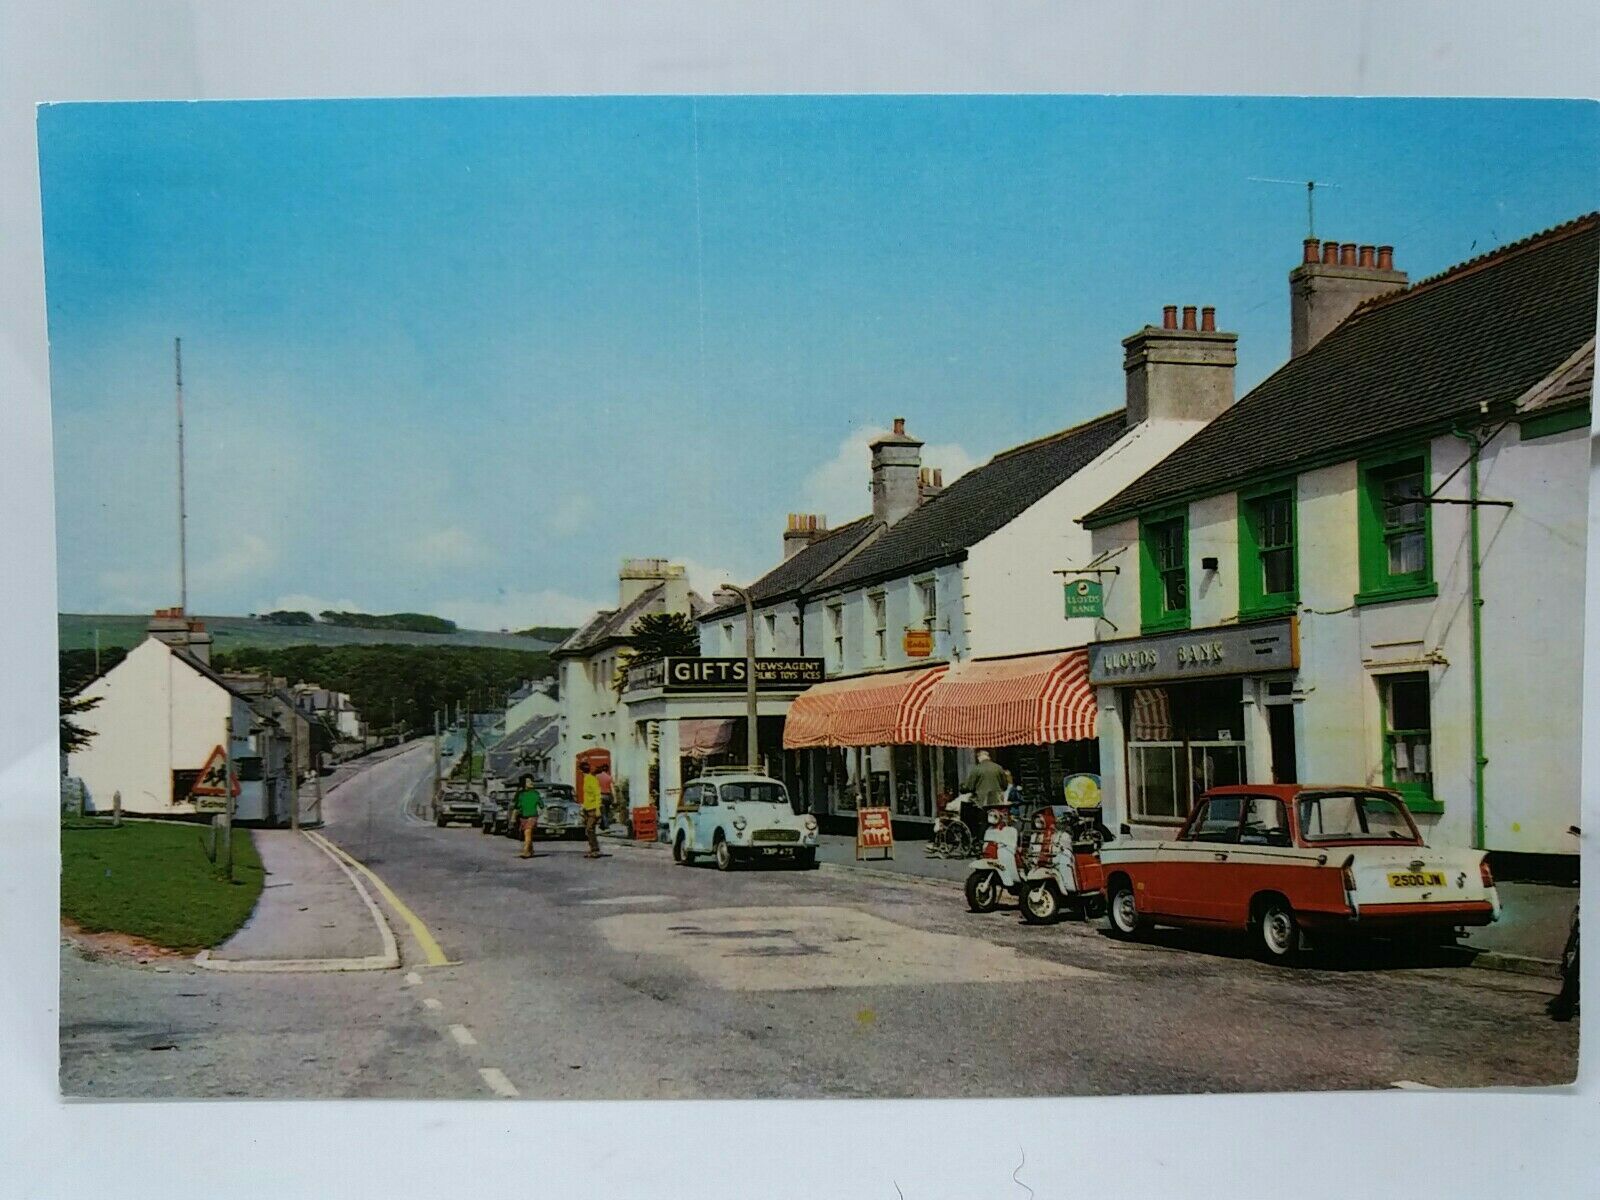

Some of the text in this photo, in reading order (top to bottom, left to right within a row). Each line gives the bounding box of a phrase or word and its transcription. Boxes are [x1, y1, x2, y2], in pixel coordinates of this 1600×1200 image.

[1067, 595, 1100, 604] LLOYDS
[1072, 604, 1097, 613] BANK
[1103, 642, 1224, 670] LLOYDS BANK
[754, 662, 820, 670] NEWSAGENT
[674, 662, 745, 681] GIFTS
[780, 671, 798, 680] TOYS
[802, 671, 821, 680] ICES
